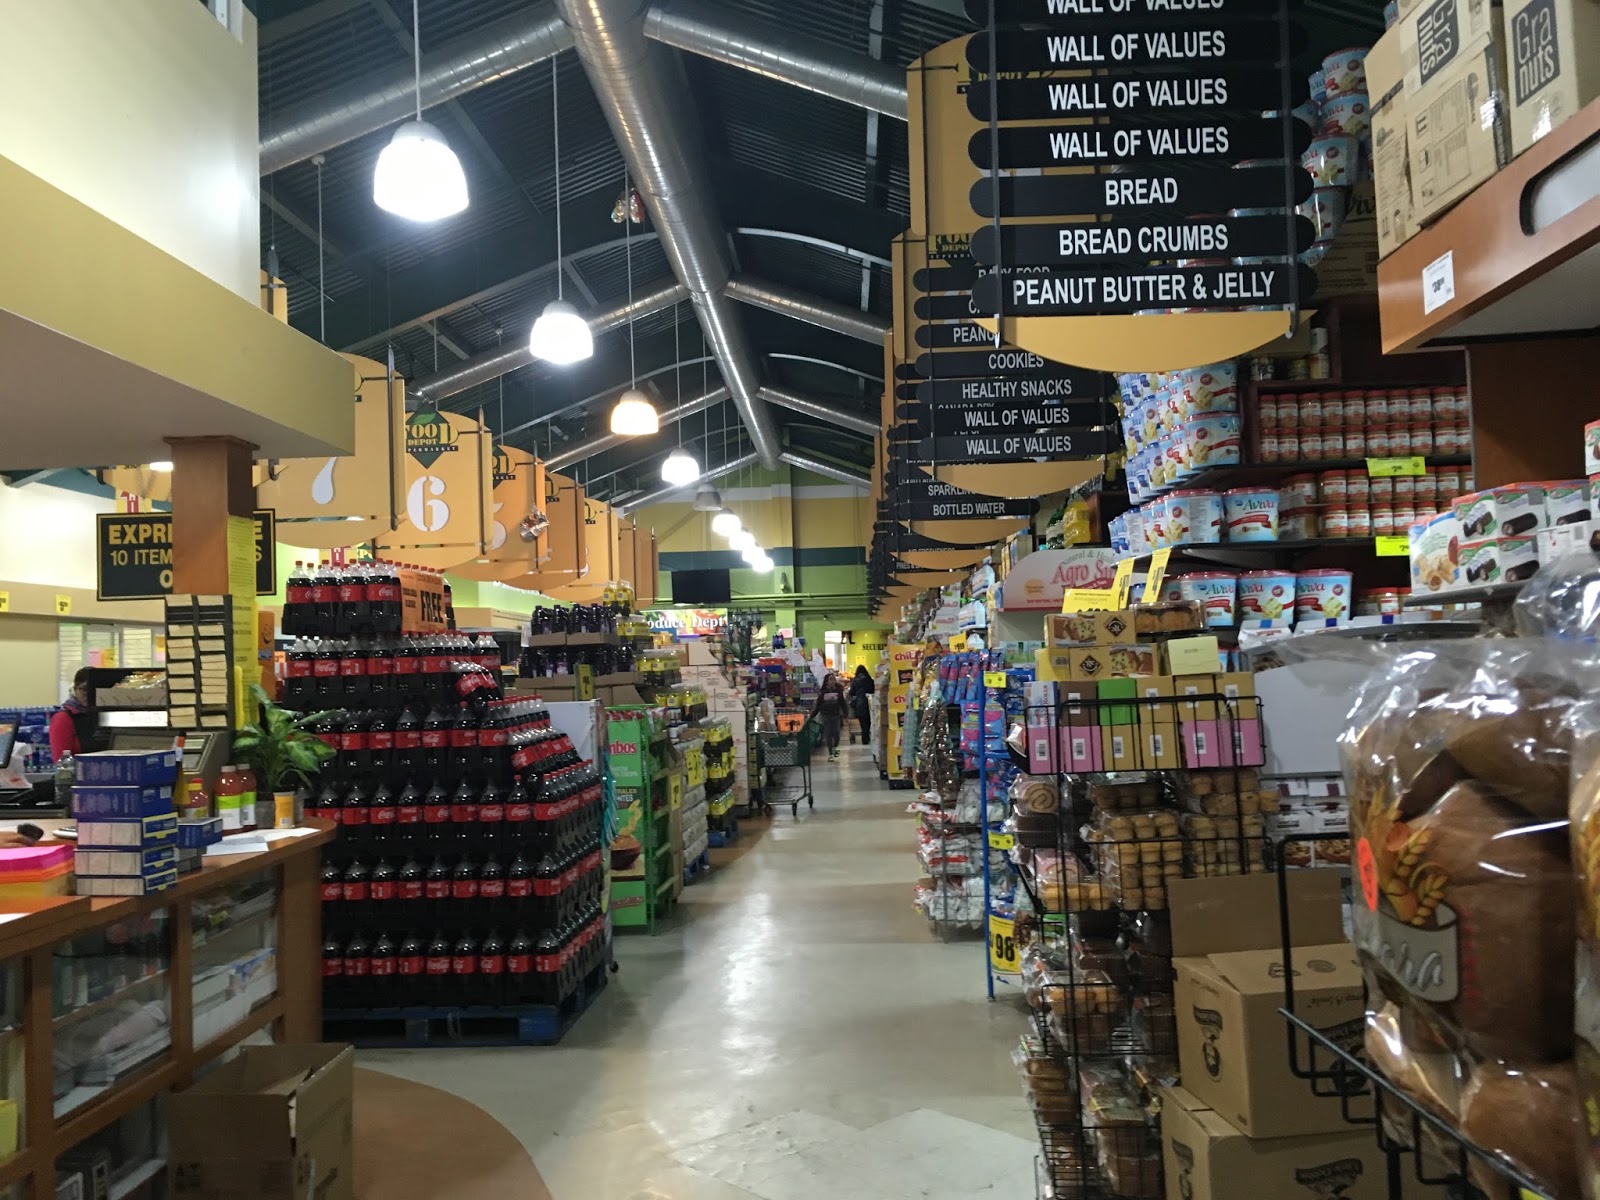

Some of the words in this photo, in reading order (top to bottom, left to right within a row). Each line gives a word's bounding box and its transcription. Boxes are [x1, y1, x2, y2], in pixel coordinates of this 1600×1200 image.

[1047, 35, 1105, 62] WALL
[1110, 33, 1139, 60] OF
[1144, 30, 1226, 58] VALUES
[1516, 7, 1552, 65] Gra
[1519, 44, 1555, 99] nuts
[1048, 82, 1107, 110] WALL
[1112, 81, 1140, 108] OF
[1146, 77, 1228, 106] VALUES
[1050, 131, 1108, 159] WALL
[1113, 129, 1142, 157] OF
[1147, 126, 1229, 155] VALUES
[1105, 177, 1178, 206] BREAD
[1059, 227, 1132, 256] BREAD
[1137, 224, 1229, 253] CRUMBS
[1013, 277, 1096, 305] PEANUT
[1102, 273, 1186, 303] BUTTER
[1192, 273, 1207, 300] &
[1212, 271, 1275, 299] JELLY
[988, 353, 1044, 370] COOKIES
[962, 381, 1018, 399] HEALTHY
[1020, 379, 1072, 397] SNACKS
[964, 410, 999, 427] WALL
[1002, 409, 1019, 426] OF
[1021, 407, 1070, 424] VALUES
[408, 438, 438, 446] DEPOT
[966, 439, 1000, 455] WALL
[1003, 437, 1021, 454] OF
[1023, 436, 1072, 453] VALUES
[406, 475, 450, 532] 6
[933, 503, 973, 516] BOTTLED
[975, 502, 1006, 514] WATER
[110, 550, 128, 566] 10
[1051, 562, 1089, 588] Agro
[420, 590, 444, 624] FREE
